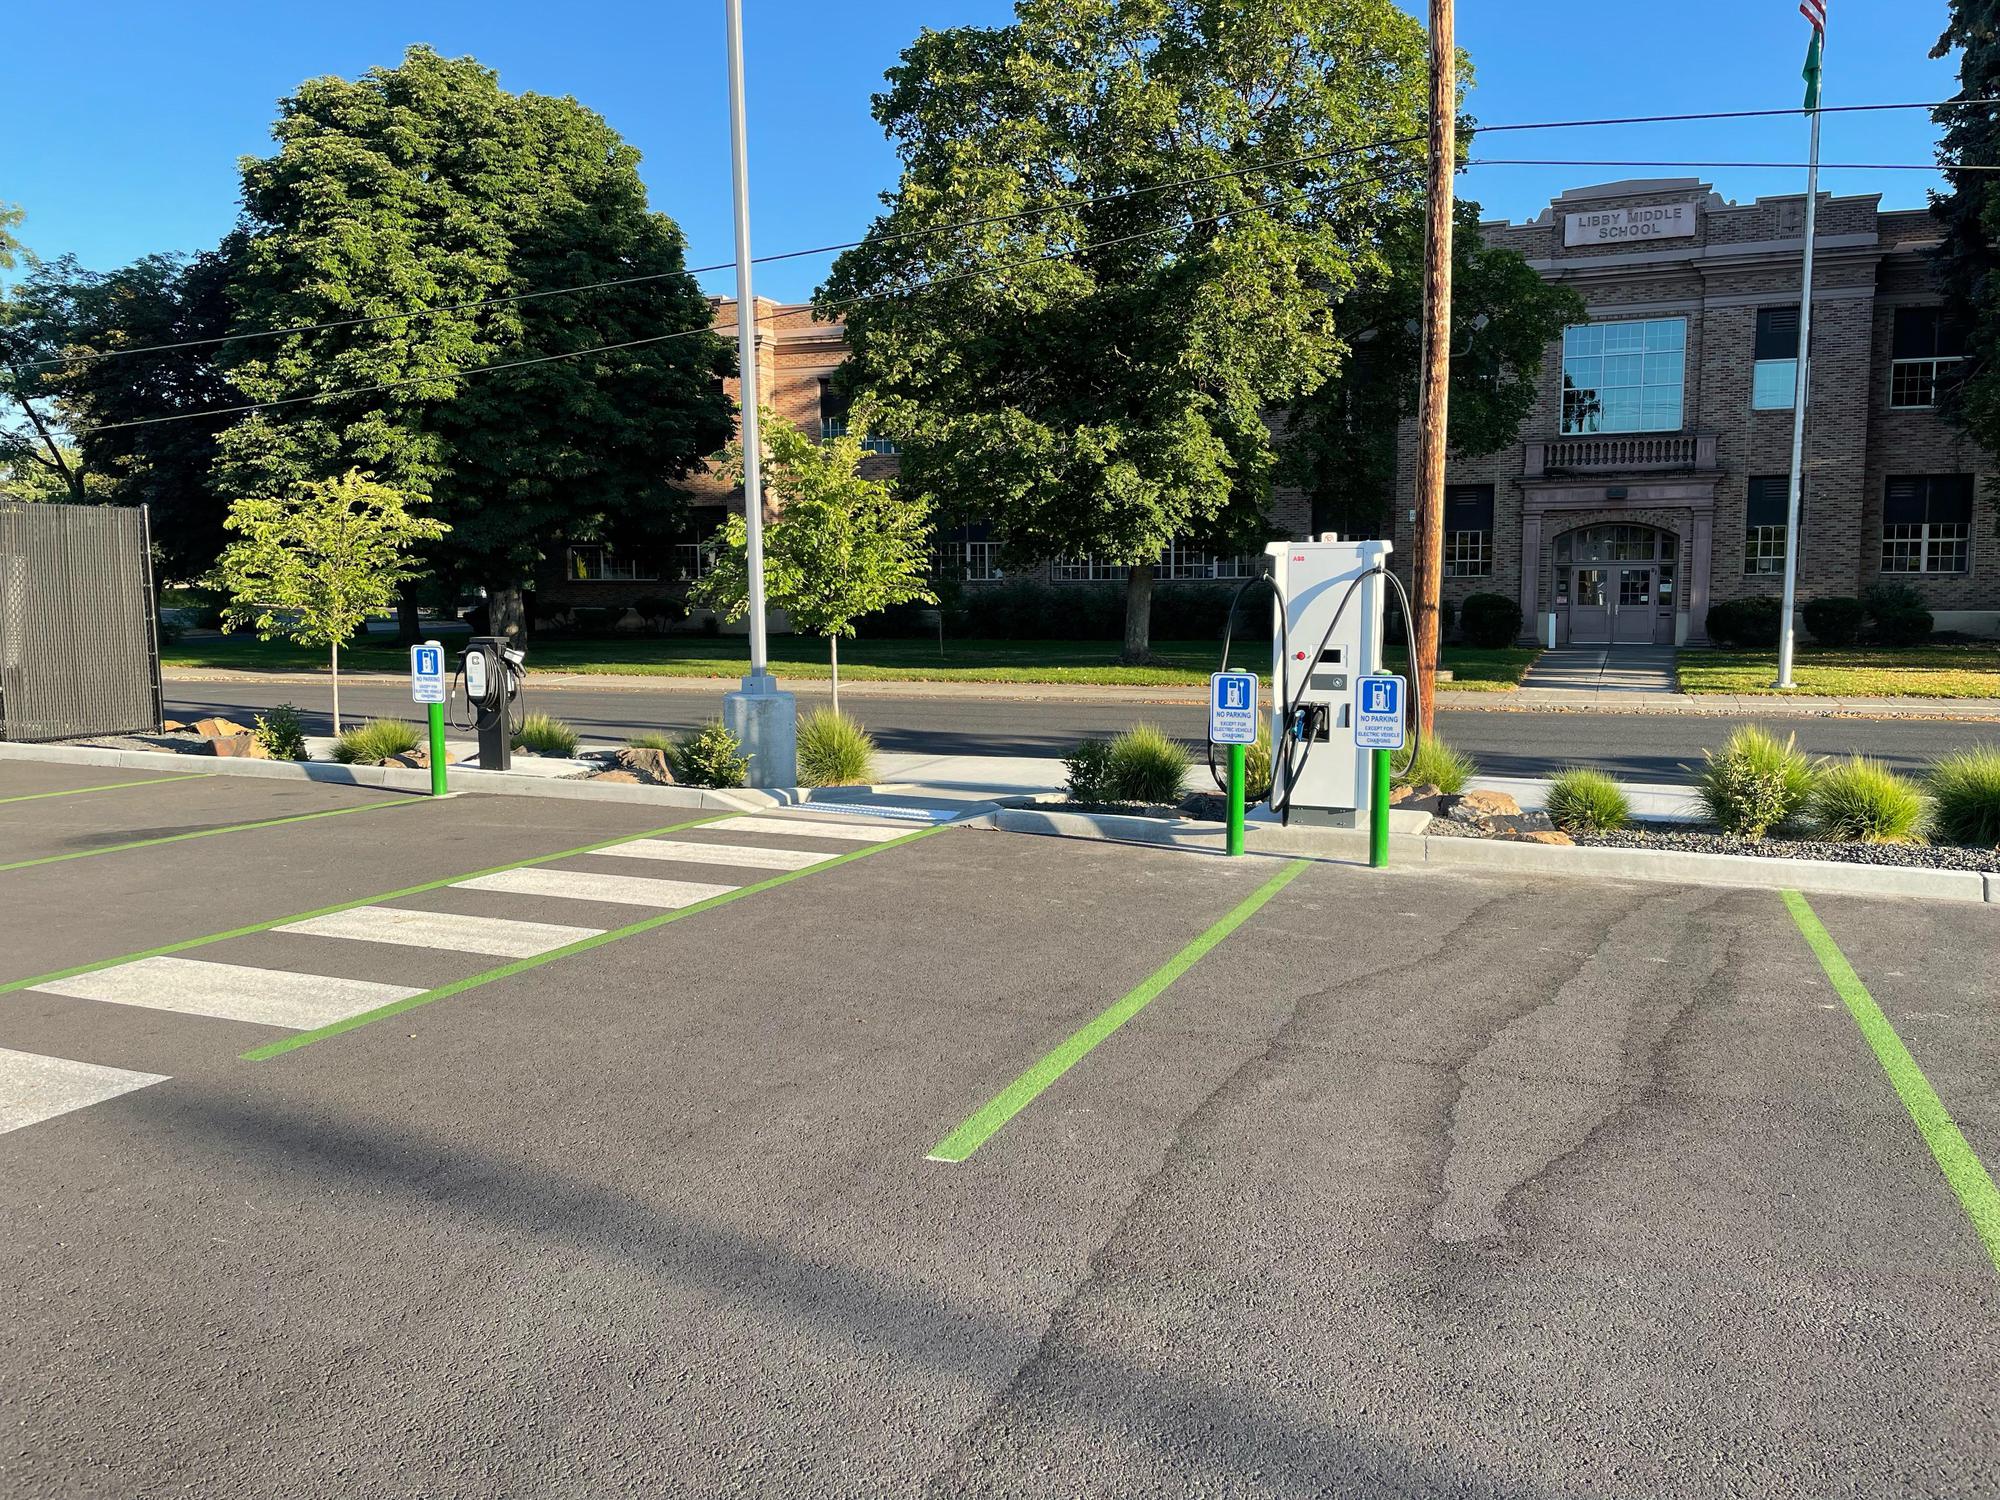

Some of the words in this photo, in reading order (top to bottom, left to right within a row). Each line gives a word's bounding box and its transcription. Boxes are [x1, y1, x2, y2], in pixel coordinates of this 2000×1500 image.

[1579, 214, 1620, 227] LIBBY
[1627, 208, 1682, 222] MIDDLE
[1599, 224, 1661, 238] SCHOOL
